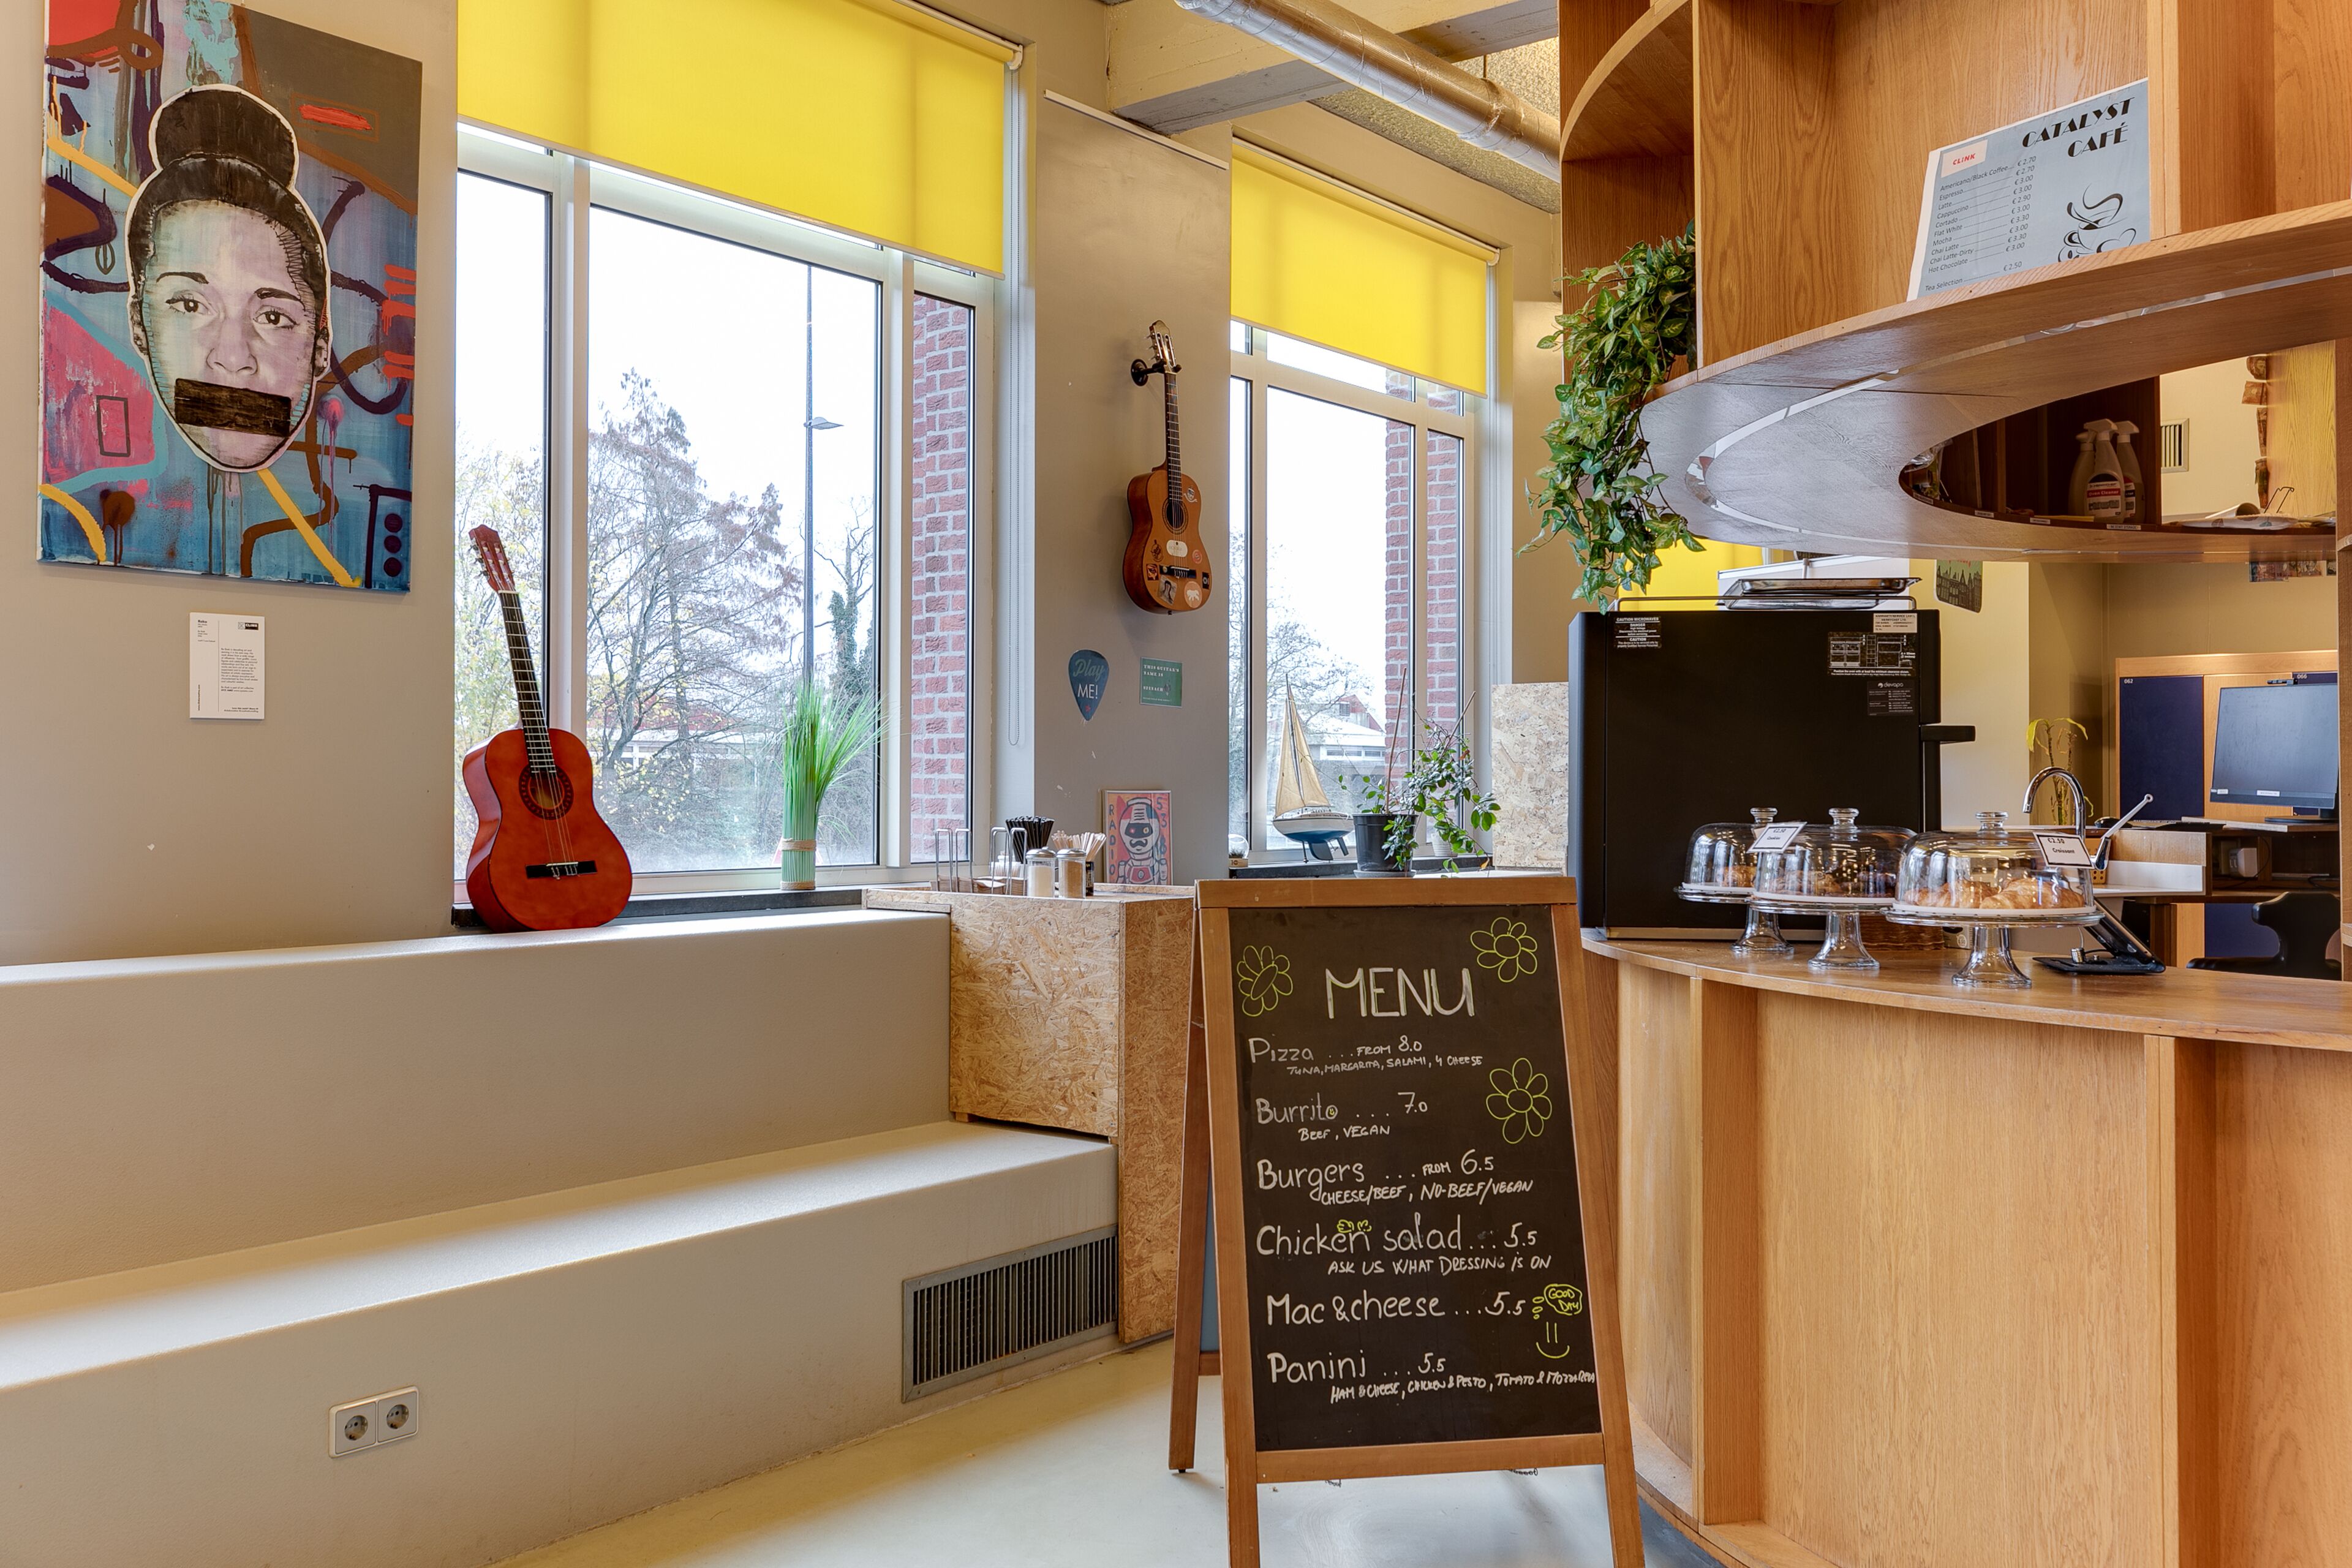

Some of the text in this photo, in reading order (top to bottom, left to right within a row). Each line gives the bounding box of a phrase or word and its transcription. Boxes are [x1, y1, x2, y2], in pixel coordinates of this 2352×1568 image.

[2022, 97, 2135, 148] CATALYST
[2067, 122, 2128, 157] CAFÉ
[1940, 172, 1988, 191] Americano/Black
[1989, 165, 2008, 176] Coffee
[1939, 189, 1964, 201] Espresso
[1937, 205, 1969, 219] Cappuccino
[1938, 202, 1952, 210] Latte
[1936, 217, 1958, 228] Cortado
[1946, 225, 1962, 235] White
[1932, 236, 1952, 246] Mocha
[1943, 249, 1974, 261] Latte-Dirty
[1940, 259, 1969, 271] Chocolate
[1937, 278, 1963, 289] Selection
[1073, 659, 1104, 682] Play
[1077, 683, 1098, 699] ME!
[1325, 968, 1475, 1019] MENU
[1248, 1034, 1422, 1063] Pizza FROM 8.0
[1435, 1055, 1442, 1066] 4
[1447, 1056, 1483, 1066] CHEESE
[1255, 1092, 1428, 1125] Burrito 7.0
[1343, 1125, 1390, 1139] VEGAN
[1256, 1149, 1494, 1201] Burgers FROM 6.5
[1256, 1212, 1538, 1256] Chicken salad 5.5
[1327, 1258, 1355, 1275] ASK
[1363, 1259, 1385, 1275] US
[1393, 1257, 1434, 1275] WHAT
[1438, 1256, 1506, 1276] DRESSING
[1531, 1255, 1553, 1270] ON
[1548, 1288, 1575, 1299] GOOD
[1485, 1291, 1526, 1316] 5.5
[1558, 1300, 1579, 1312] DAY
[1267, 1349, 1447, 1383] Panini 5.5
